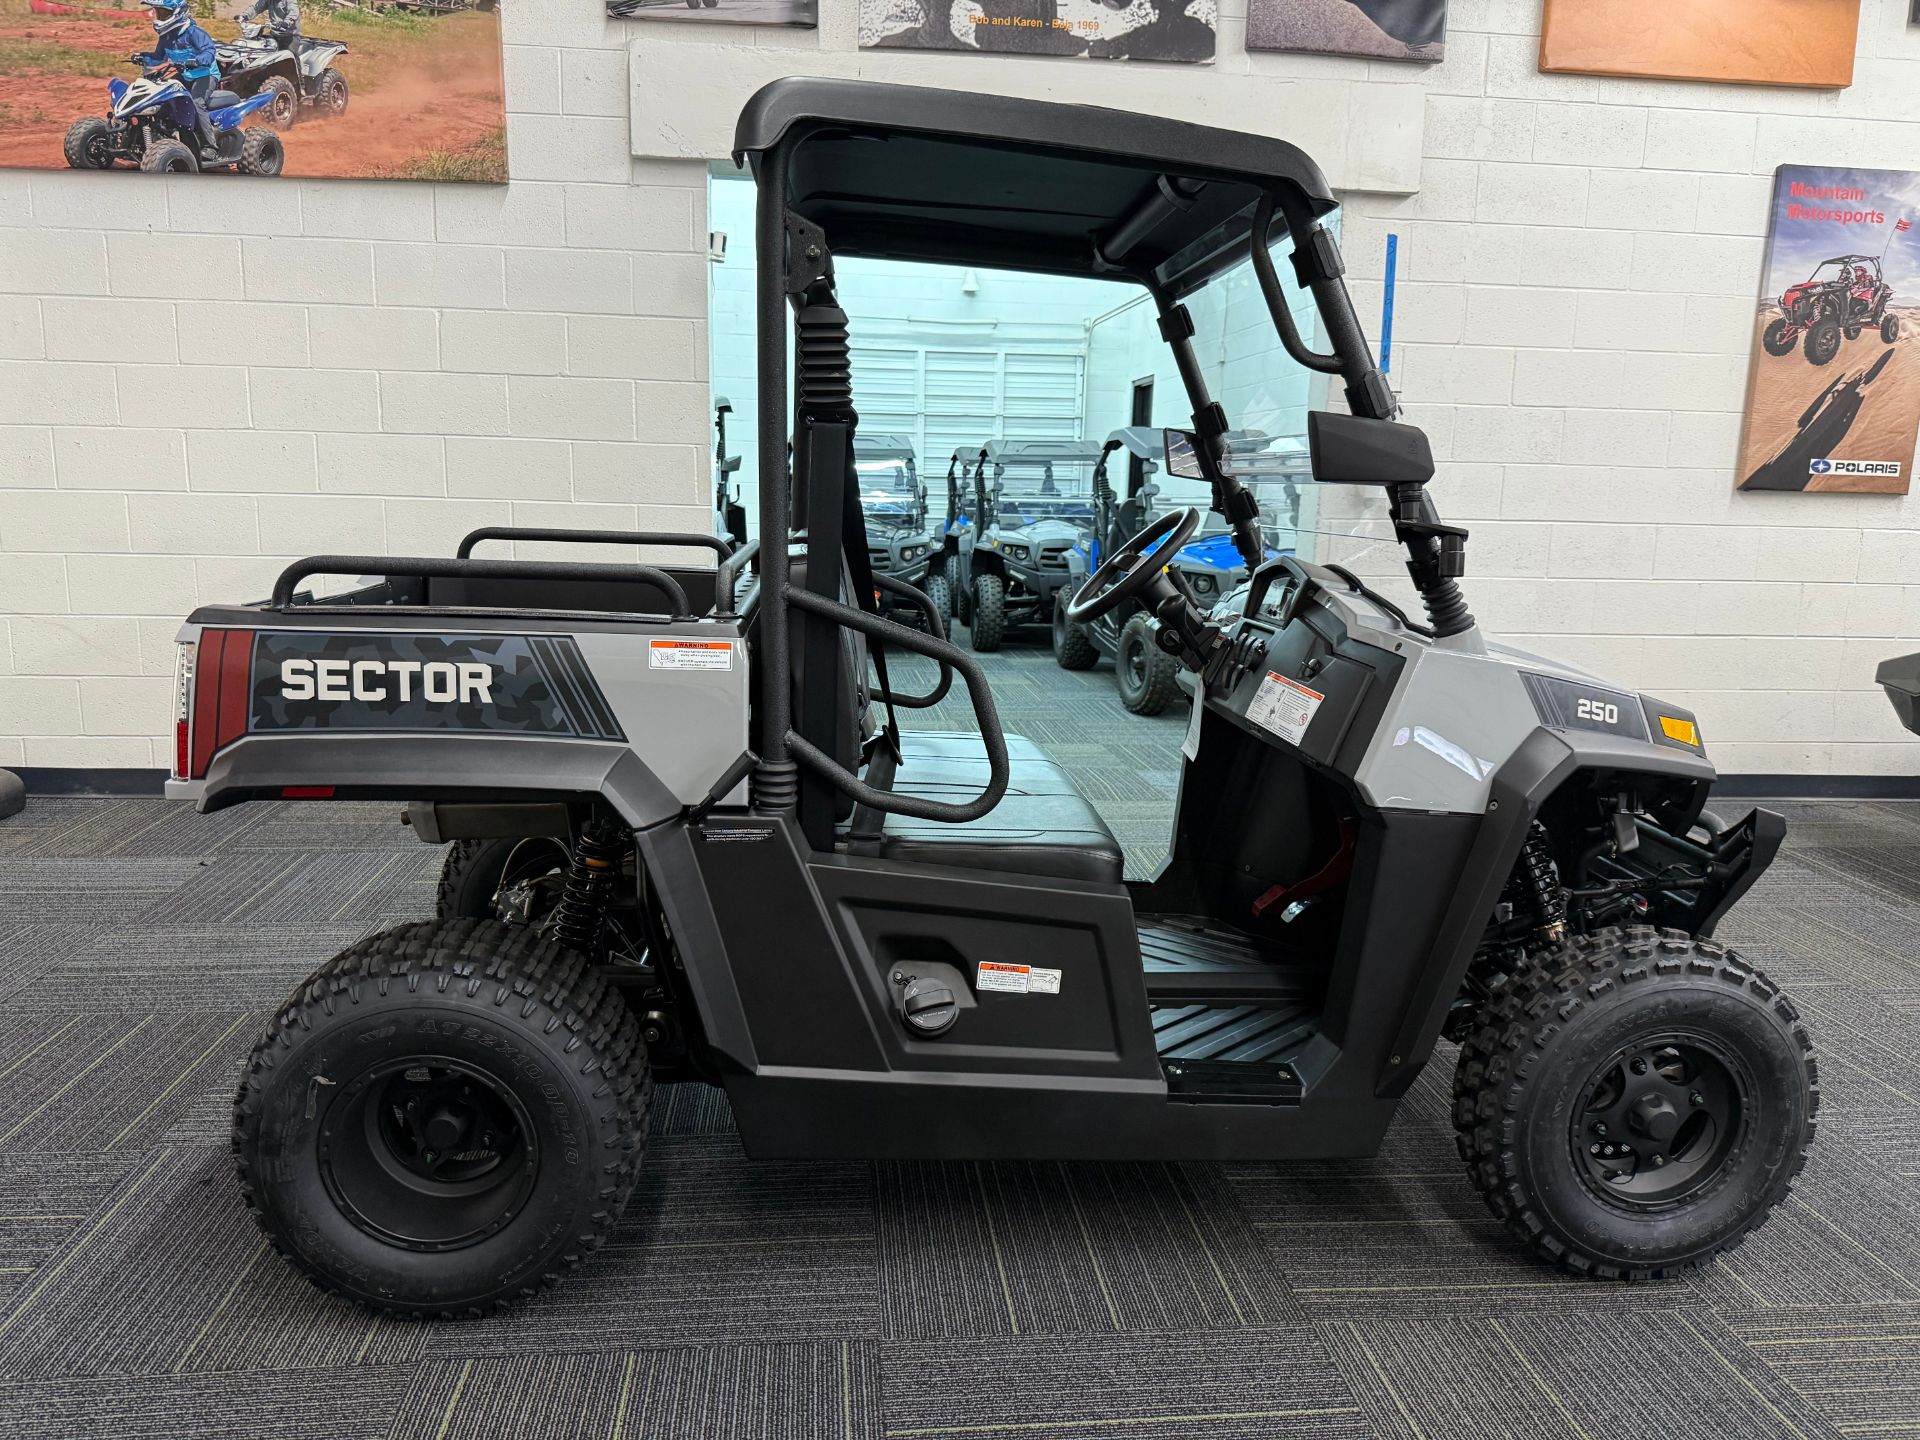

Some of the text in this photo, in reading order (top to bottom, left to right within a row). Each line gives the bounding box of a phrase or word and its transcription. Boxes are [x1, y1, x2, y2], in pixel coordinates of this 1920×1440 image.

[969, 15, 989, 25] Bob
[991, 16, 1011, 26] and
[1013, 16, 1043, 28] Karen
[1052, 18, 1073, 32] Baja
[1077, 20, 1099, 30] 1969
[1790, 181, 1865, 201] Mountain
[1787, 203, 1885, 225] Motorsports
[1834, 462, 1898, 474] POLARIS
[281, 658, 493, 704] SECTOR
[1577, 698, 1618, 724] 250
